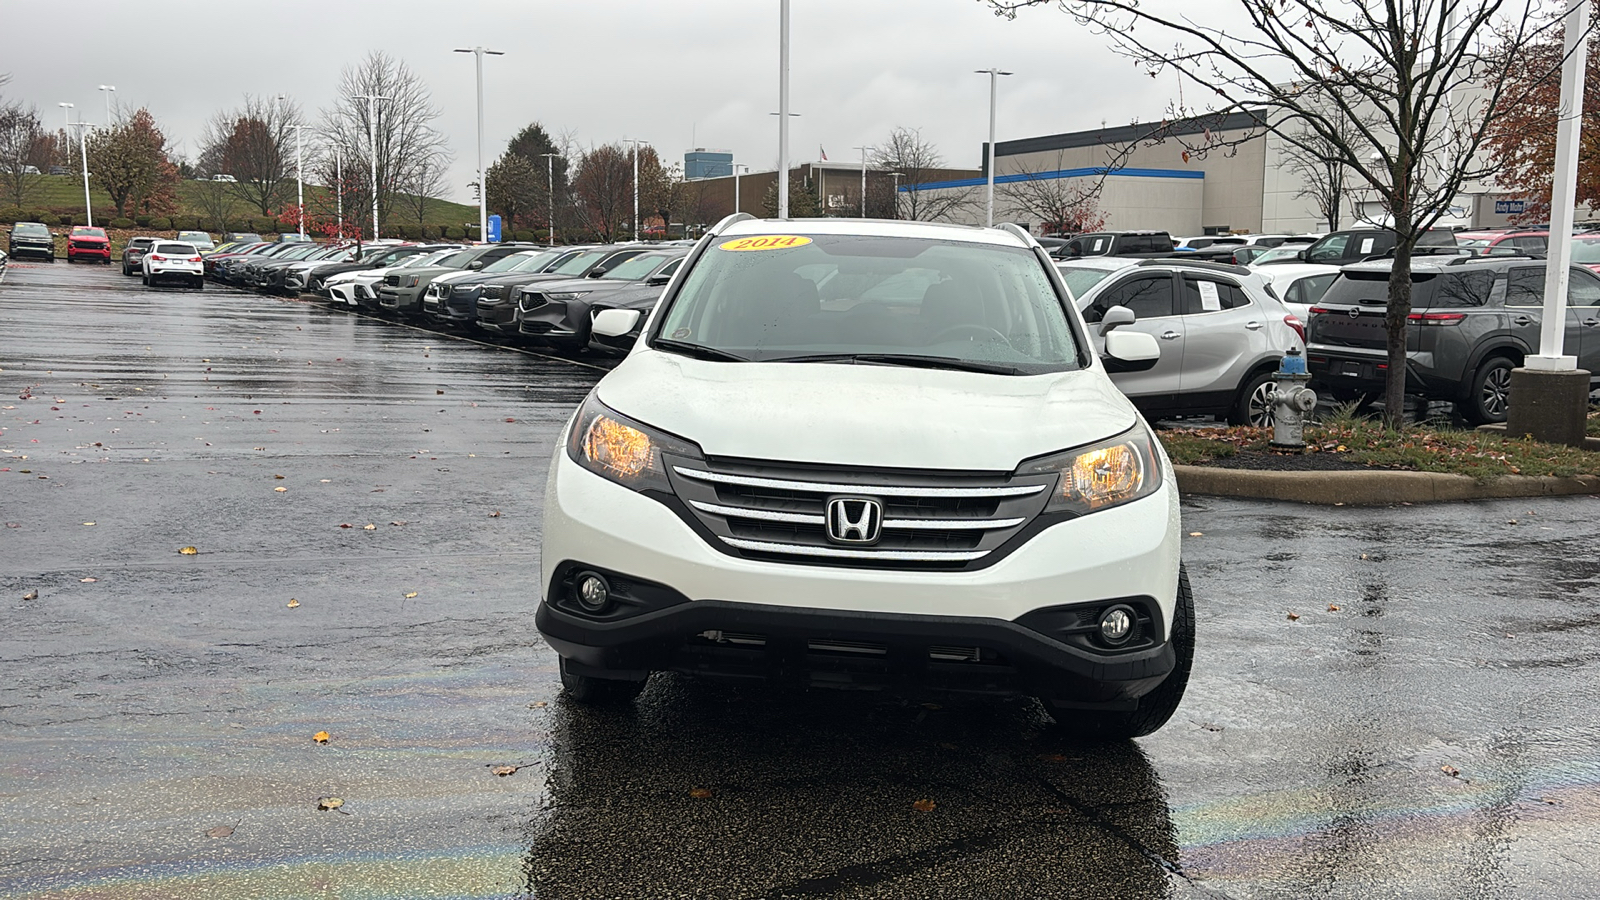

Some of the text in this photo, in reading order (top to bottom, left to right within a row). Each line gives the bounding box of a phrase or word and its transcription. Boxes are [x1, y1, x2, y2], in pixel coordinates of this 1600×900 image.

[1496, 202, 1509, 213] Andy
[734, 236, 798, 250] 2014
[1317, 318, 1388, 329] PATHFINDE
